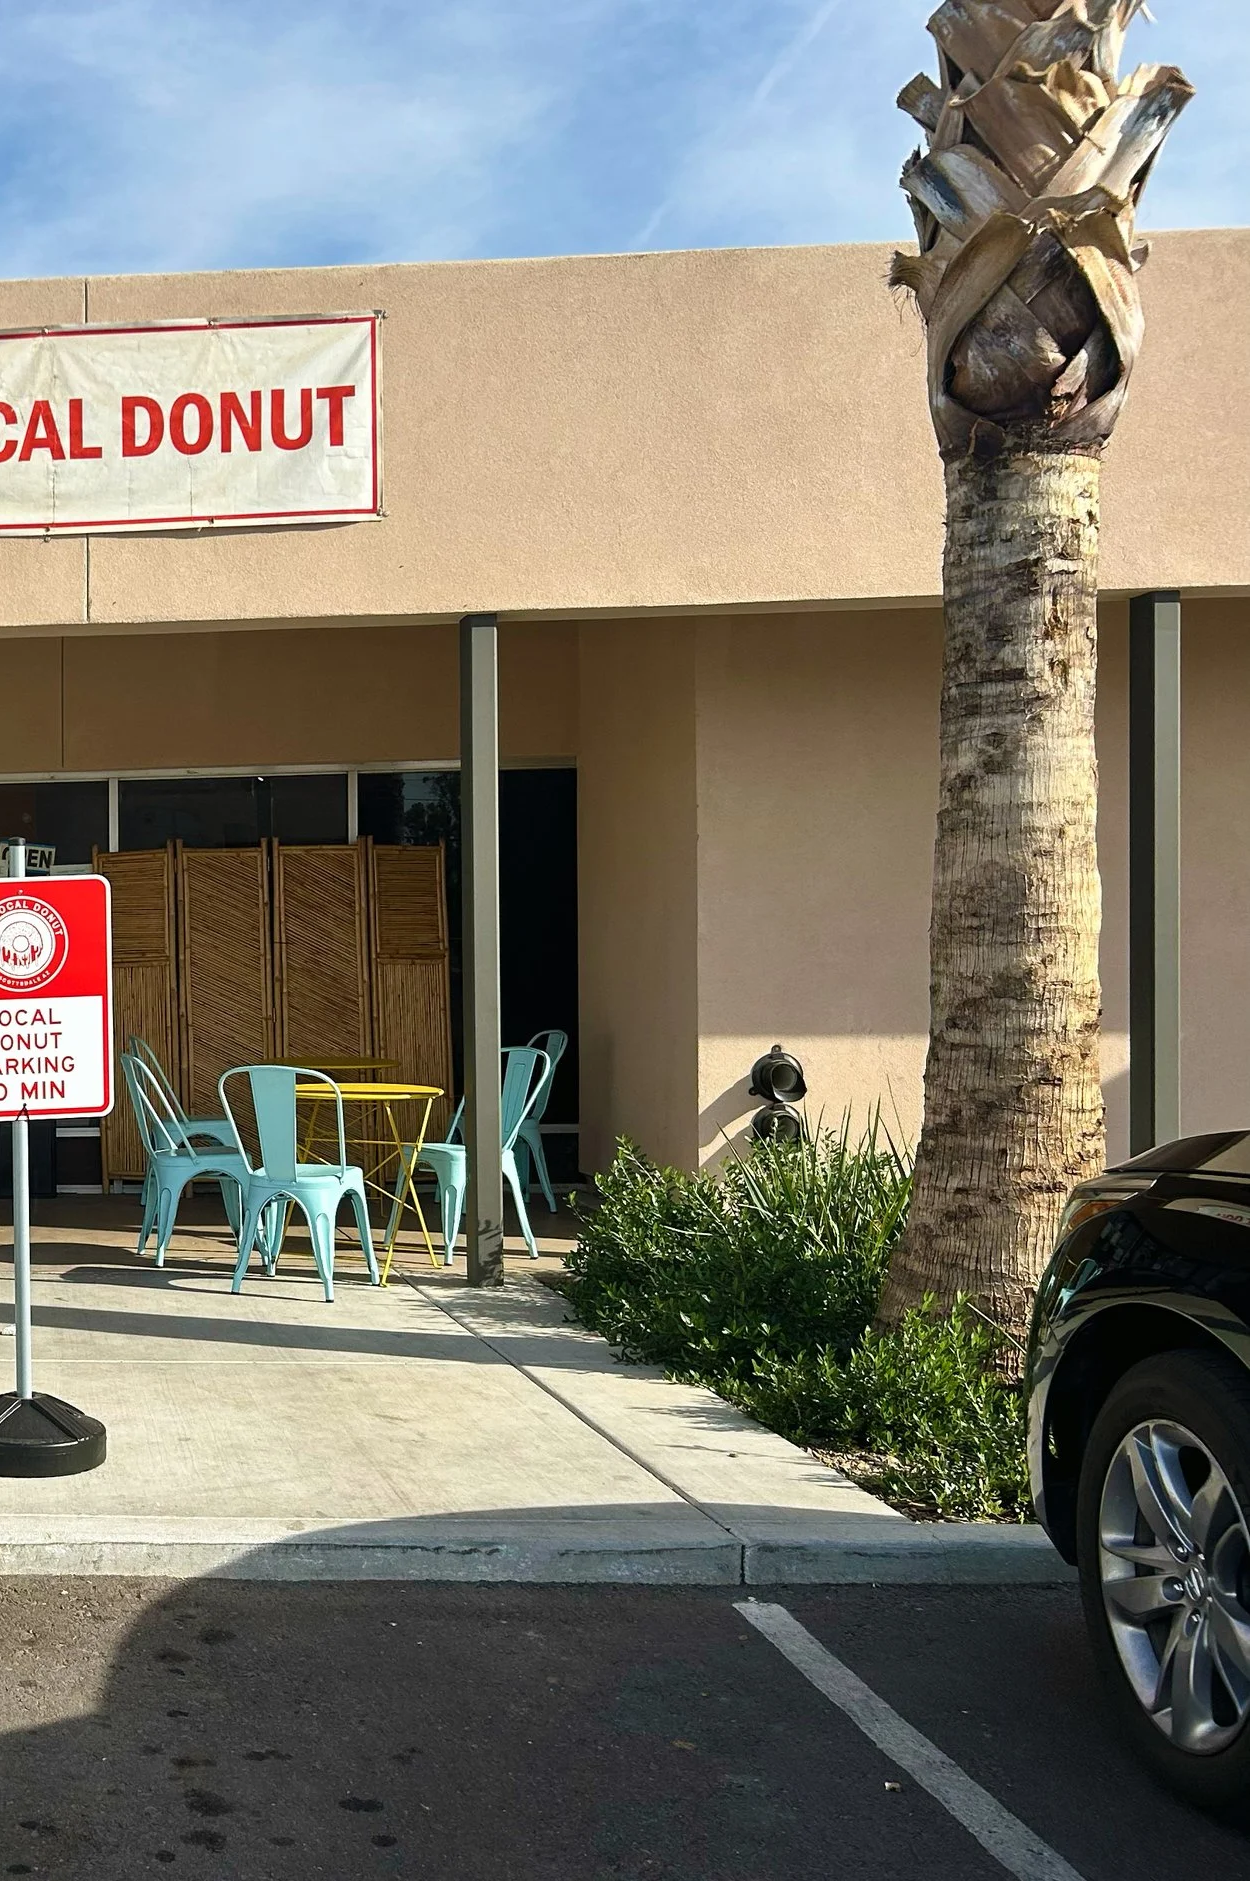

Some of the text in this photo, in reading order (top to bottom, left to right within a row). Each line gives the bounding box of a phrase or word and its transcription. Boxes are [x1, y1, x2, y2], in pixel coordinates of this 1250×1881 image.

[121, 385, 356, 458] DONUT
[2, 847, 52, 869] EN
[32, 902, 64, 936] DONUT
[21, 1080, 65, 1100] MIN
